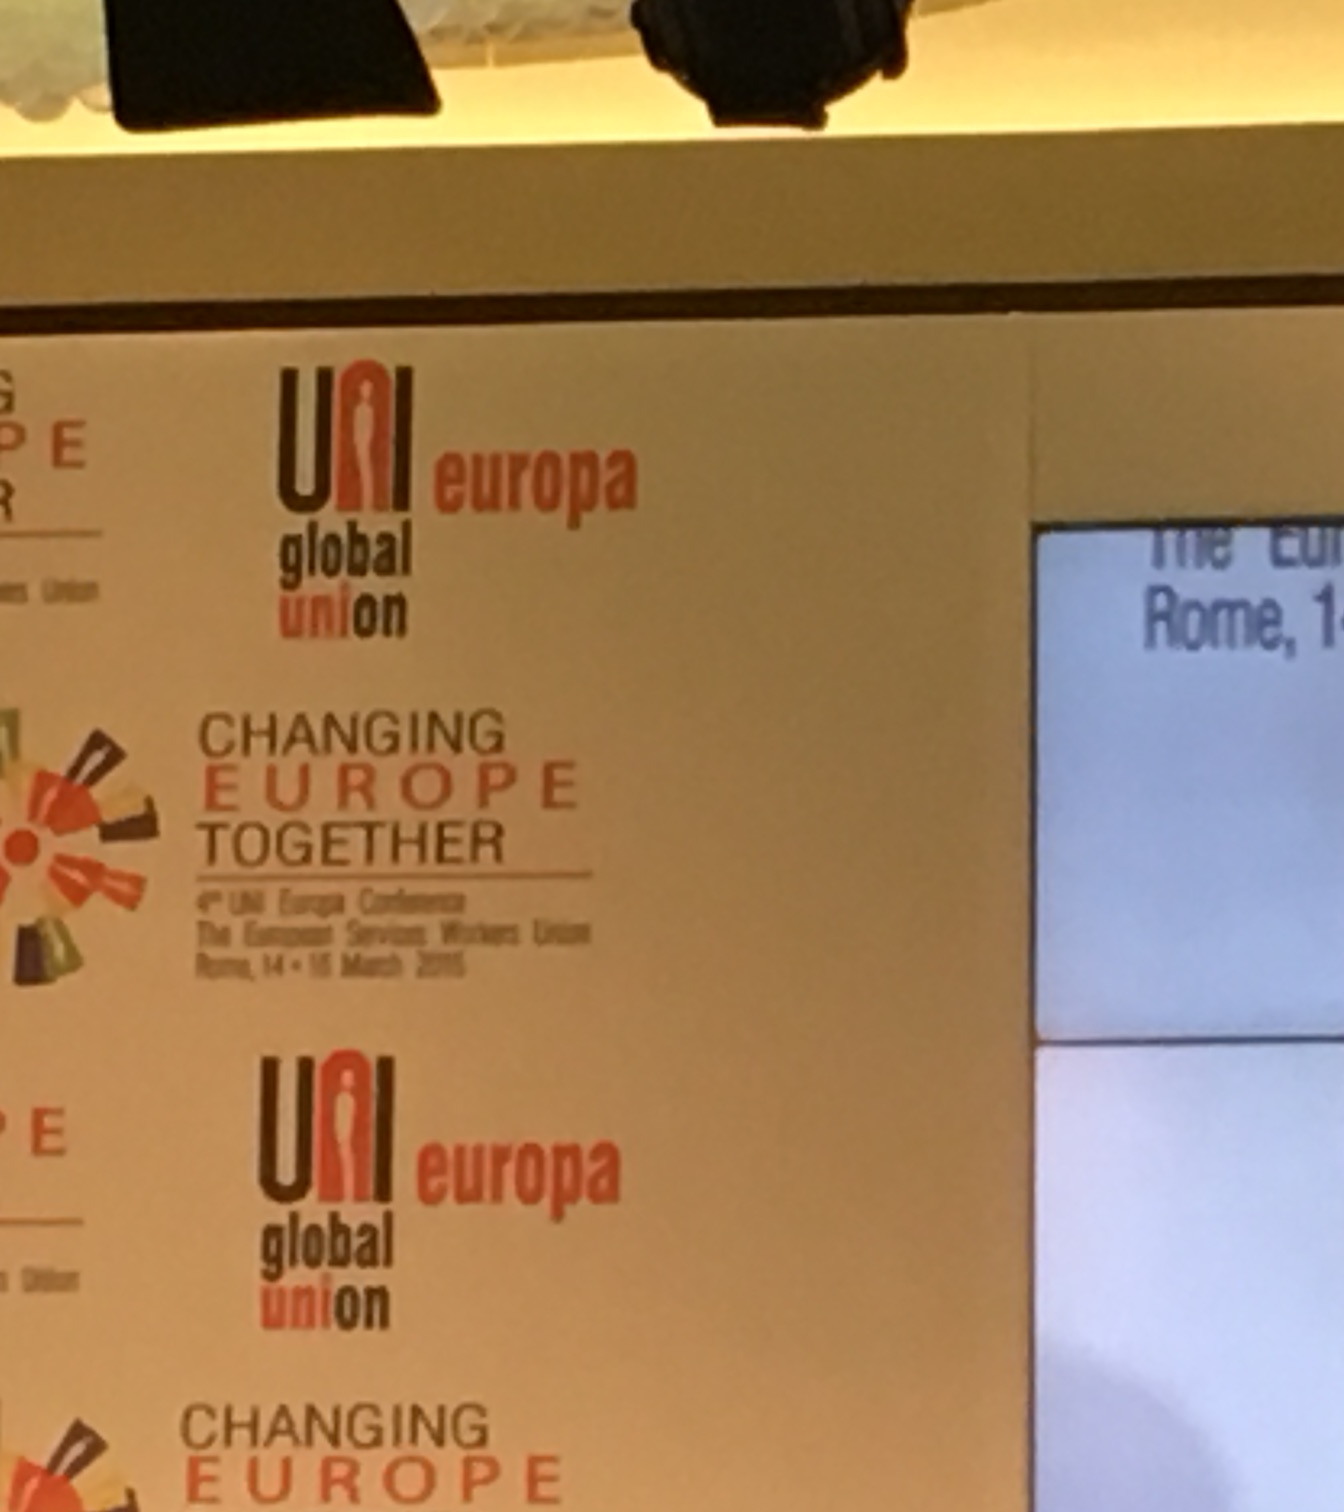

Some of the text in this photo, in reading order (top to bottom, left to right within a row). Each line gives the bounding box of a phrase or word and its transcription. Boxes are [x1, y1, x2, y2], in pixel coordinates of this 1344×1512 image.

[277, 359, 638, 530] UNI europa
[279, 520, 411, 591] global
[279, 585, 408, 639] union
[1145, 584, 1297, 660] Rome,
[198, 708, 506, 757] CHANGING
[203, 759, 578, 811] EUROPE
[196, 820, 504, 867] TOGETHER
[258, 1048, 621, 1223] UNI europa
[260, 1210, 394, 1282] global
[260, 1273, 390, 1331] union
[179, 1402, 490, 1451] CHANGING
[185, 1454, 562, 1504] EUROPE
